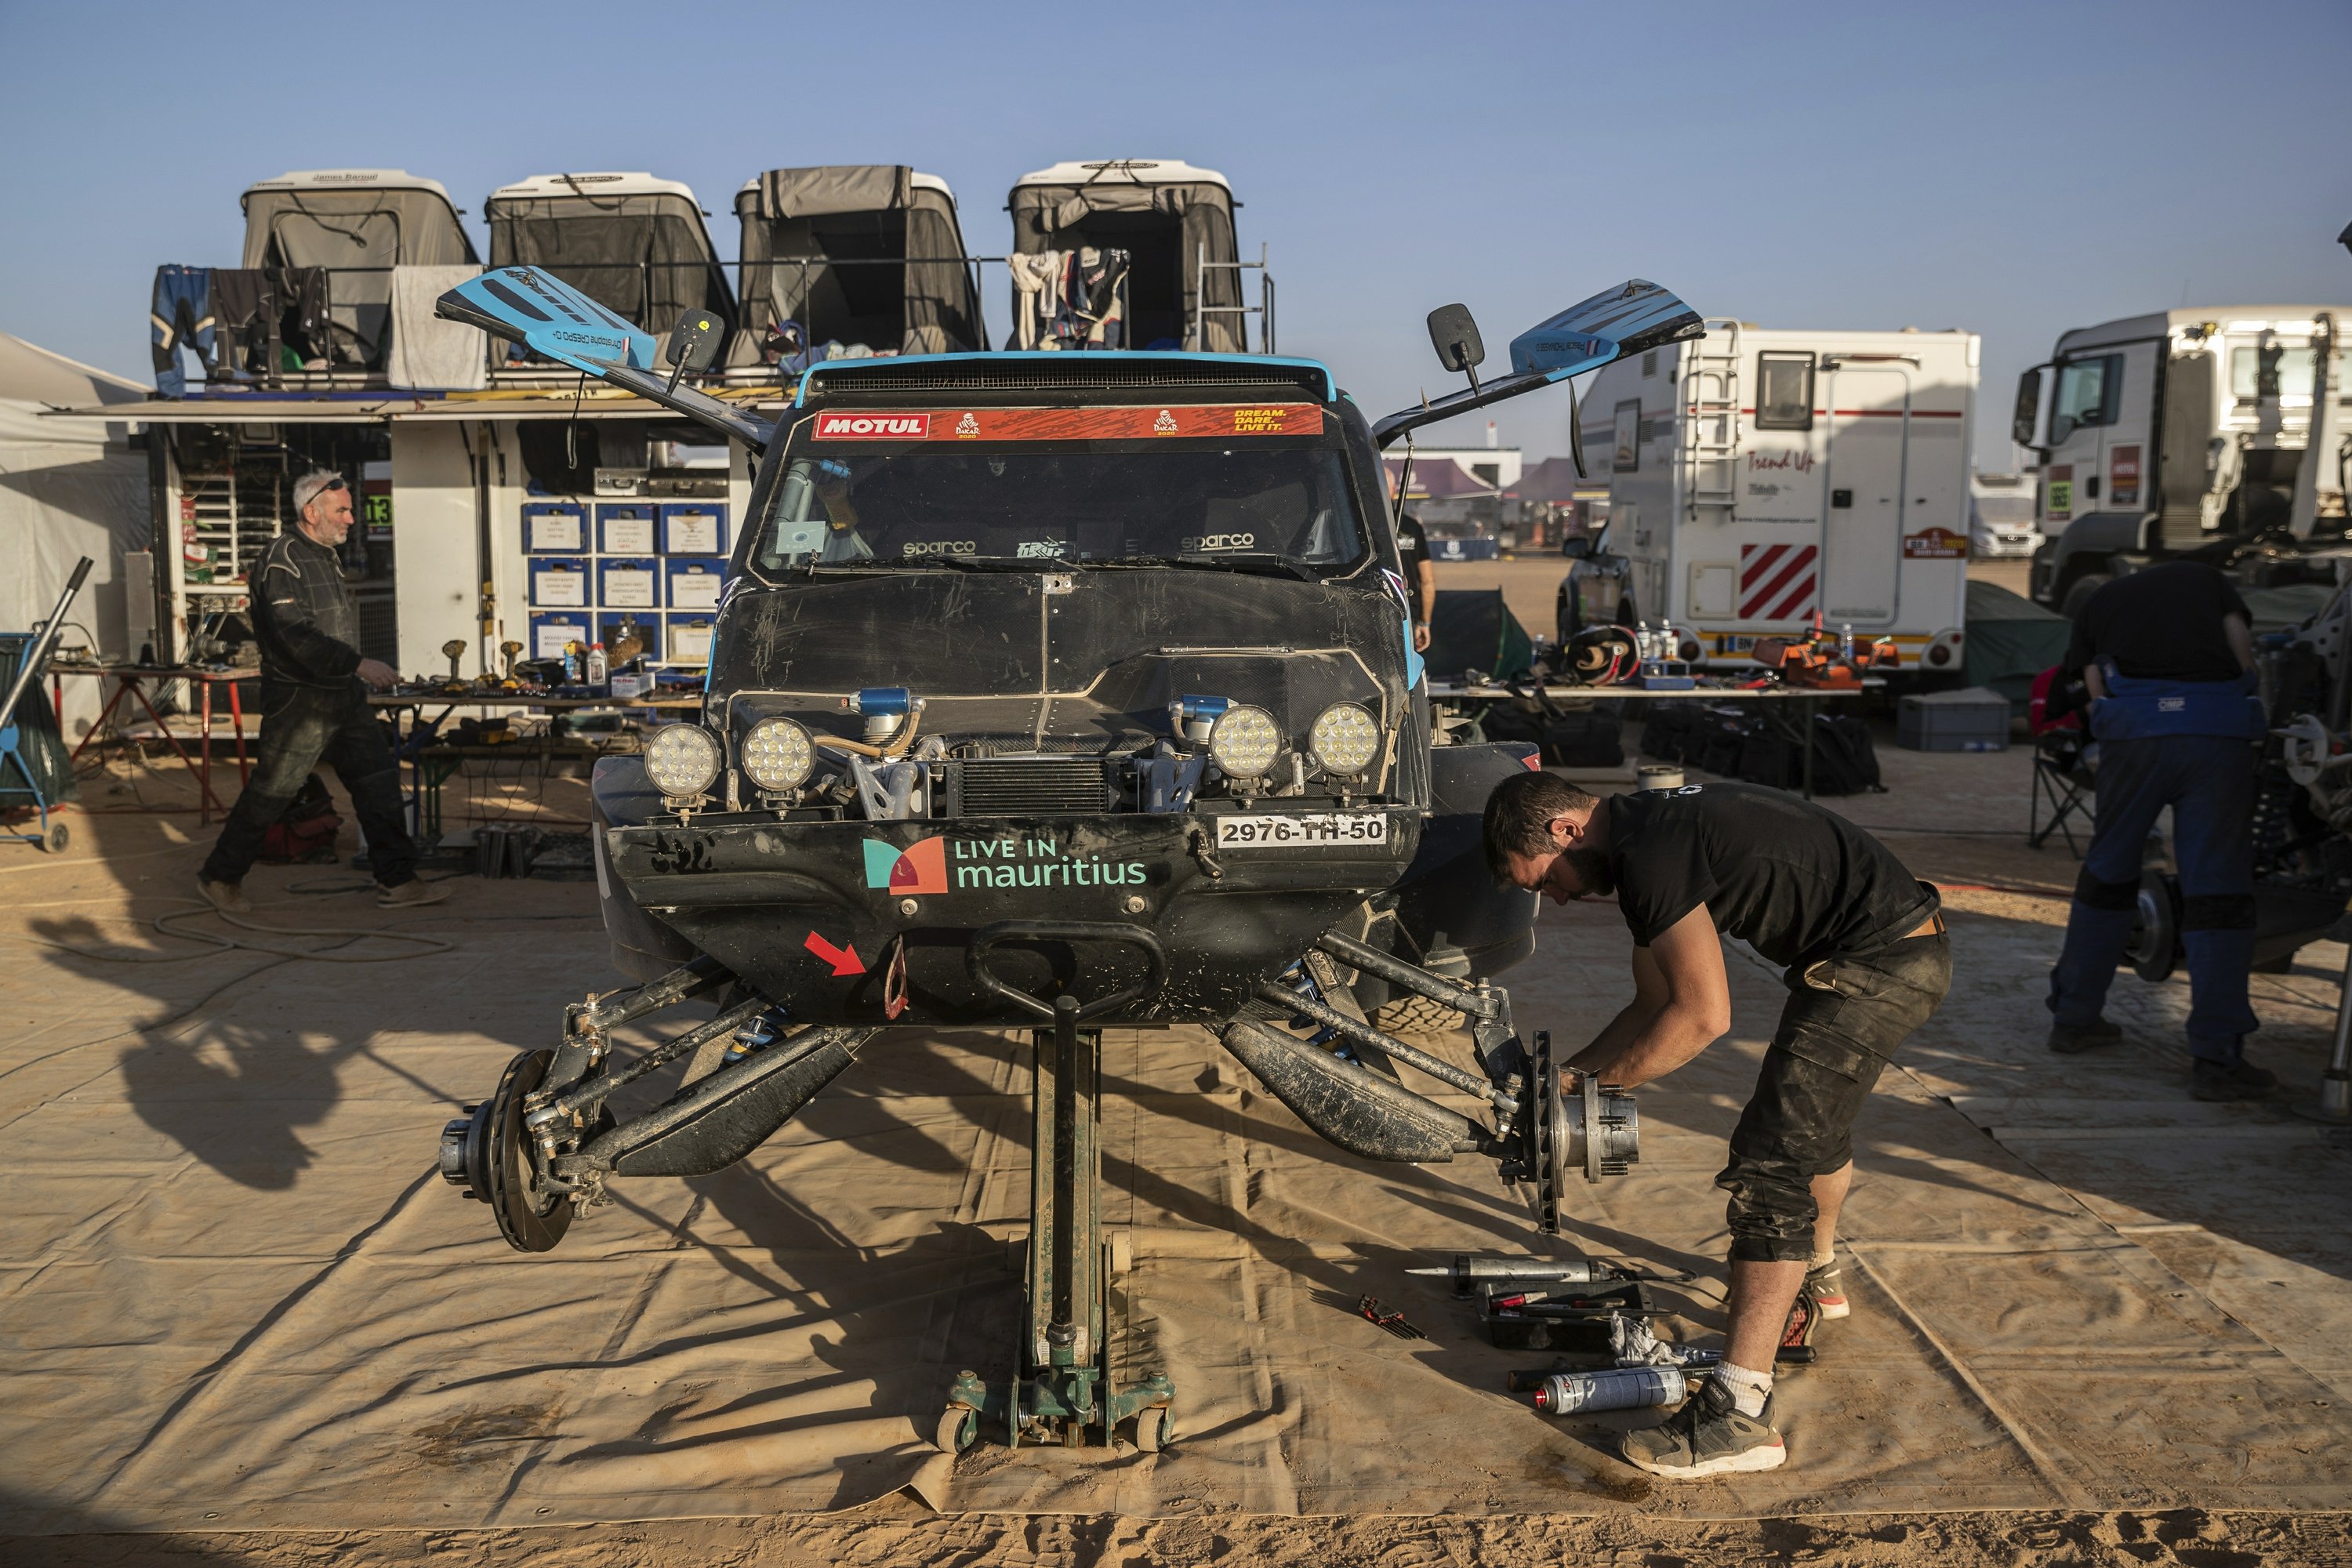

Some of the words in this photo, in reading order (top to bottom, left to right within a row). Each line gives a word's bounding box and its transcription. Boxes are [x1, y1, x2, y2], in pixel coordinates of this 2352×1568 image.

[563, 332, 589, 344] CRESPO
[823, 419, 923, 434] MOTUL
[903, 540, 976, 555] sparco
[1181, 533, 1254, 552] sparco
[2158, 699, 2186, 710] OMP
[1222, 820, 1383, 842] 2976-TH-50
[955, 840, 1016, 859] LIVE
[1027, 839, 1056, 857] IN
[957, 855, 1147, 887] mauritius
